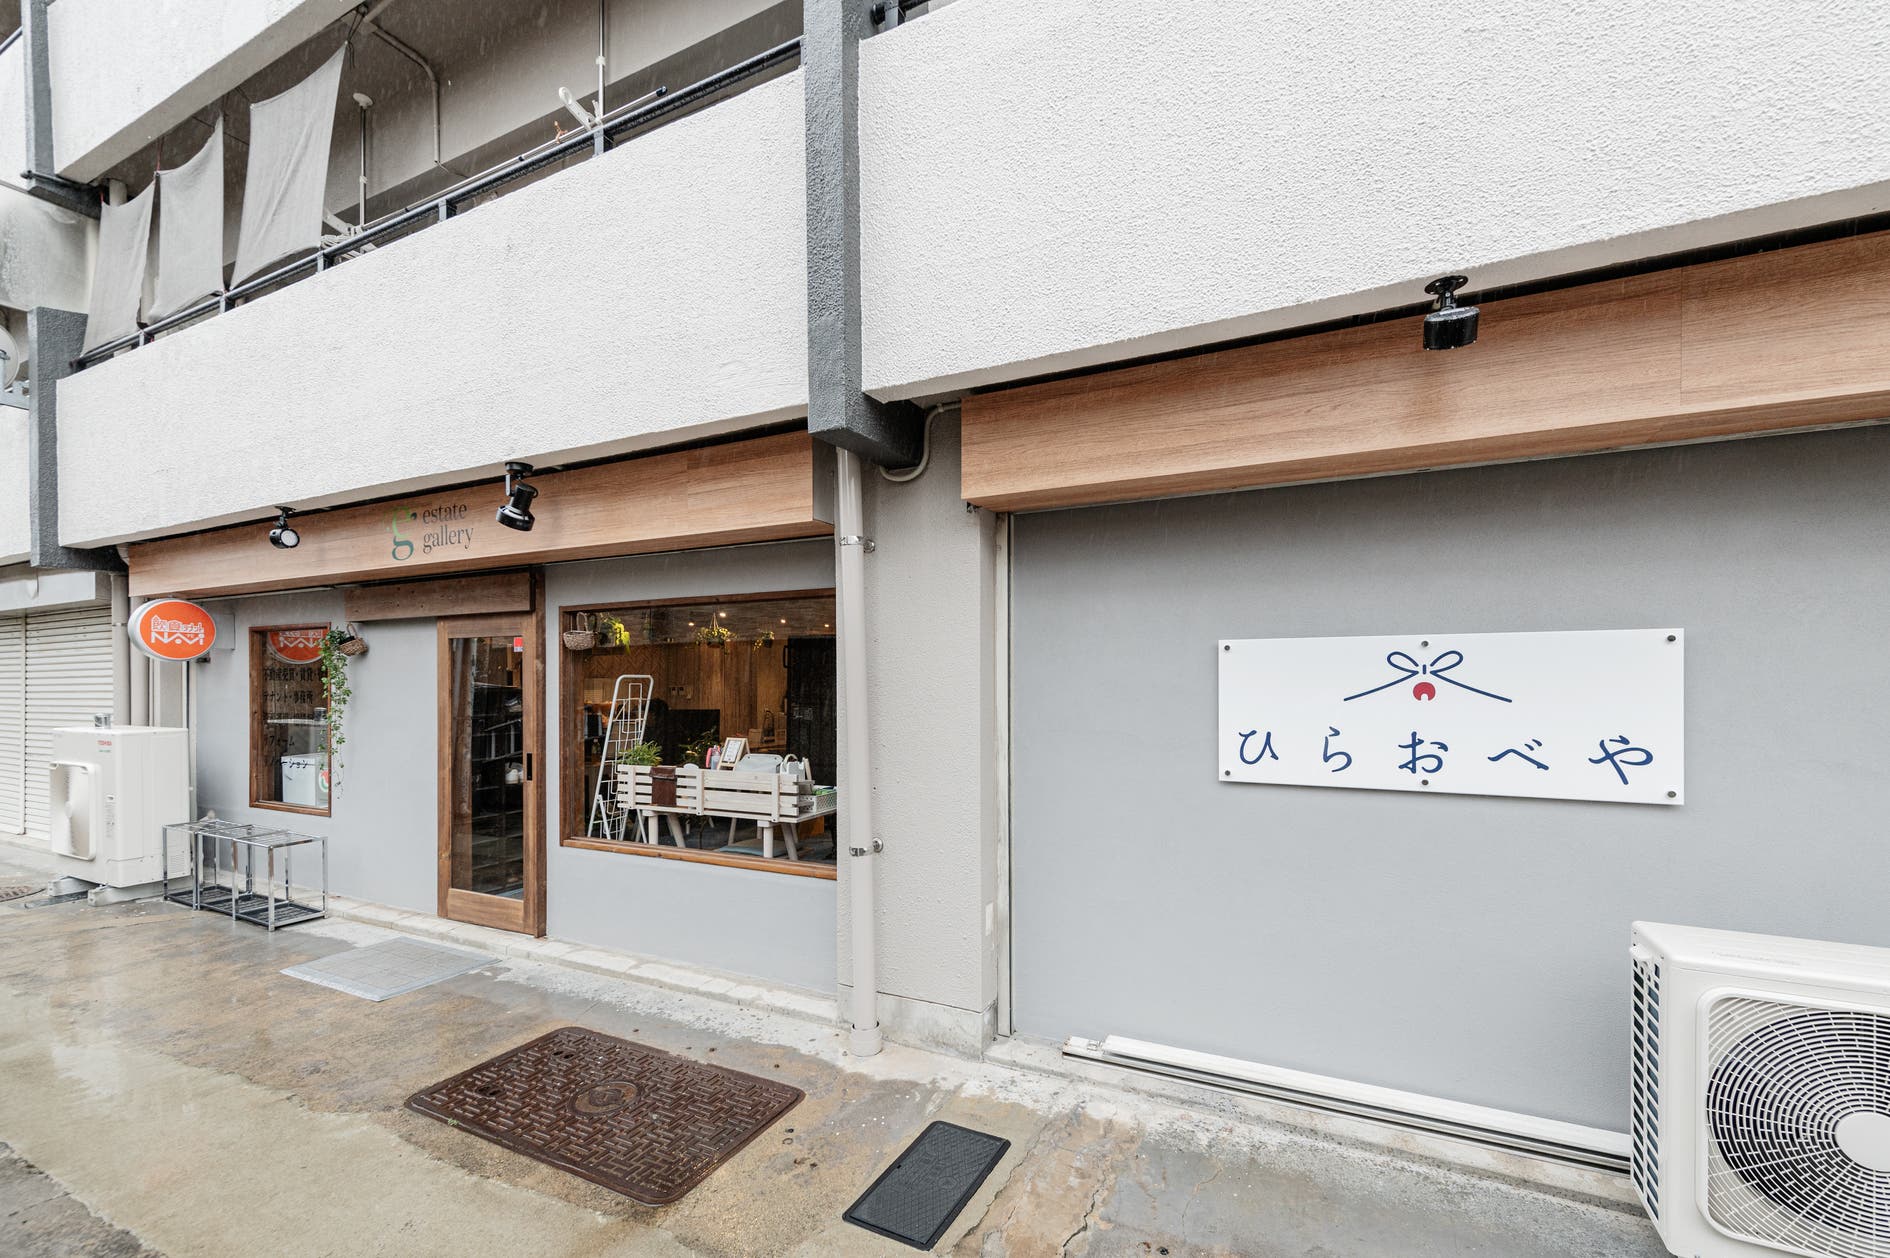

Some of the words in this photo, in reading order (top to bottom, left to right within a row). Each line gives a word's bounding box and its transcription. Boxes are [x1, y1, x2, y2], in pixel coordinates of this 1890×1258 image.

[423, 503, 467, 524] estate
[423, 525, 474, 554] gallery
[1238, 726, 1653, 785] ひらおべや
